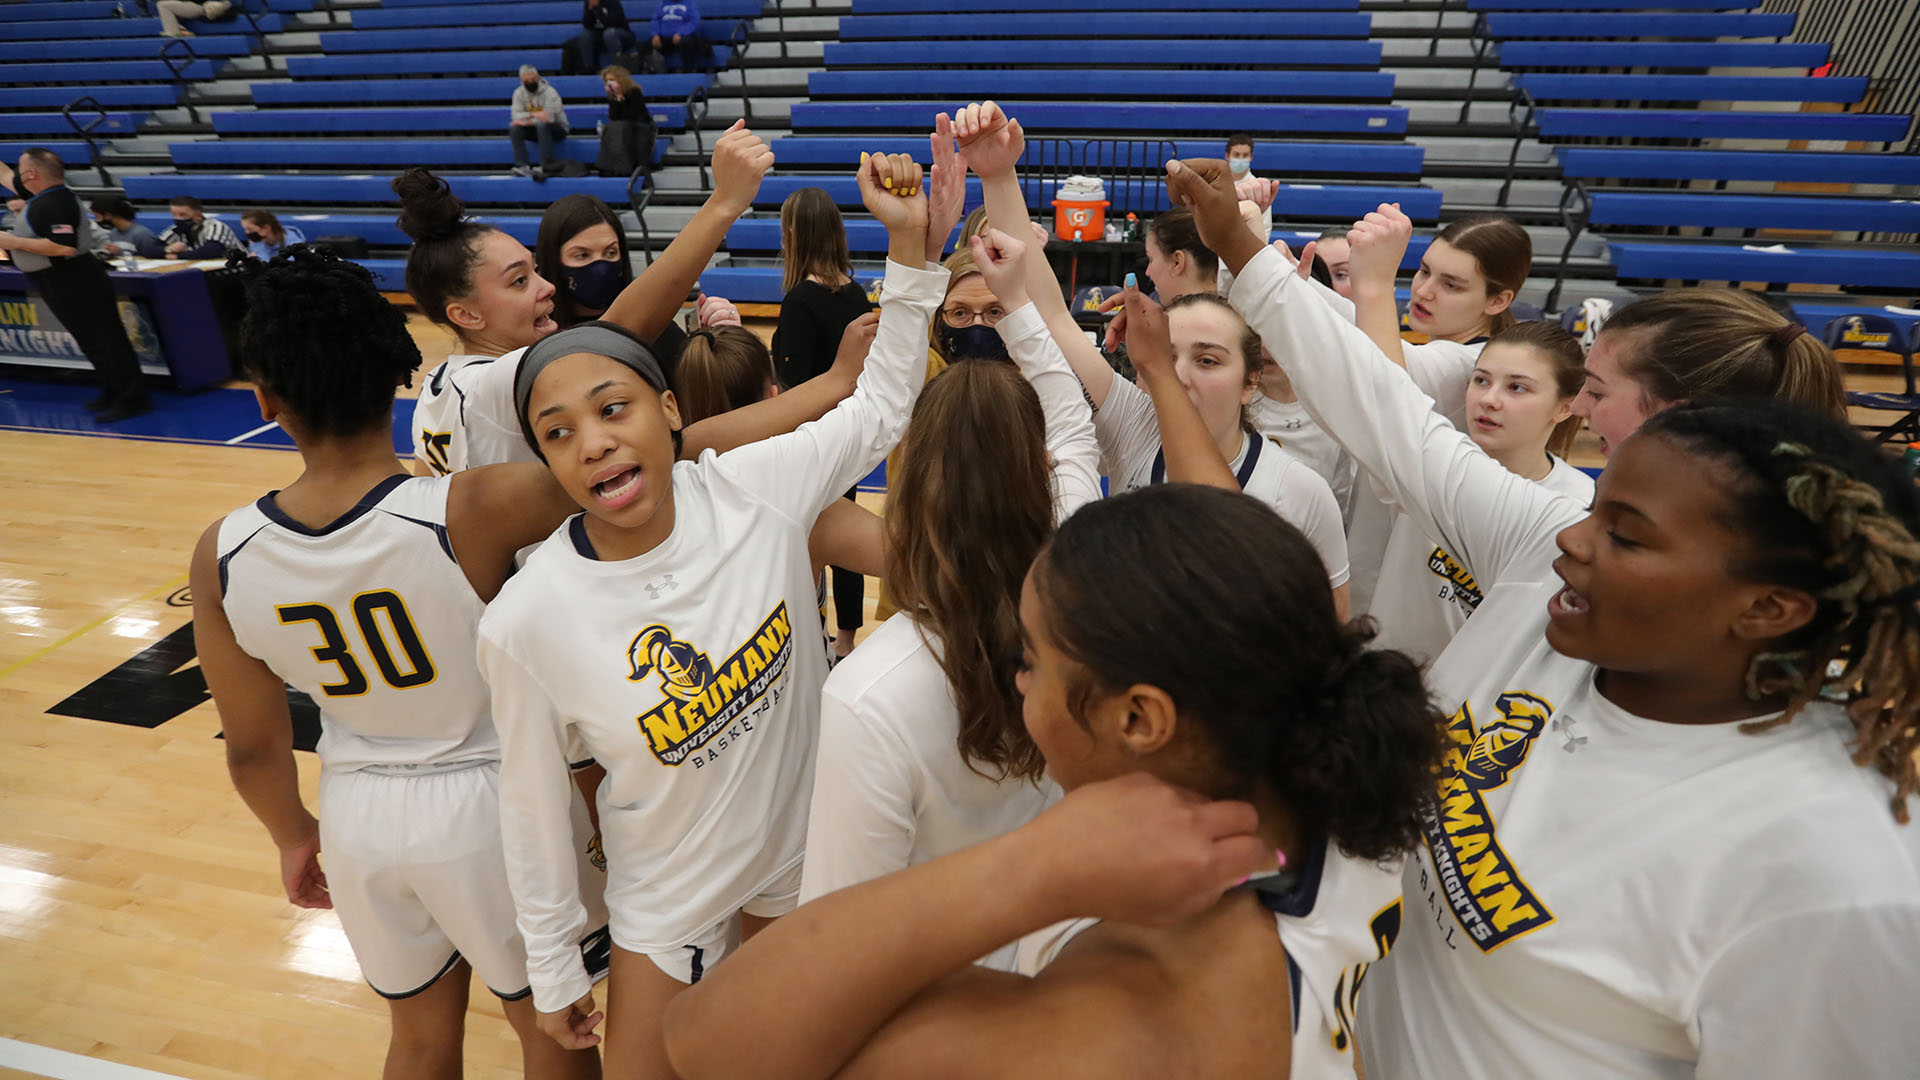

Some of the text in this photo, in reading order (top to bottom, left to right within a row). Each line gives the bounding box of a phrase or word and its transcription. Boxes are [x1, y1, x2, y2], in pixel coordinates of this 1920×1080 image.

[274, 587, 438, 699] 30
[643, 607, 791, 753] NEUMANN
[661, 693, 749, 764] UNIVERSITY
[691, 670, 790, 769] BASKETBAL
[1432, 837, 1494, 942] KNIGHTS
